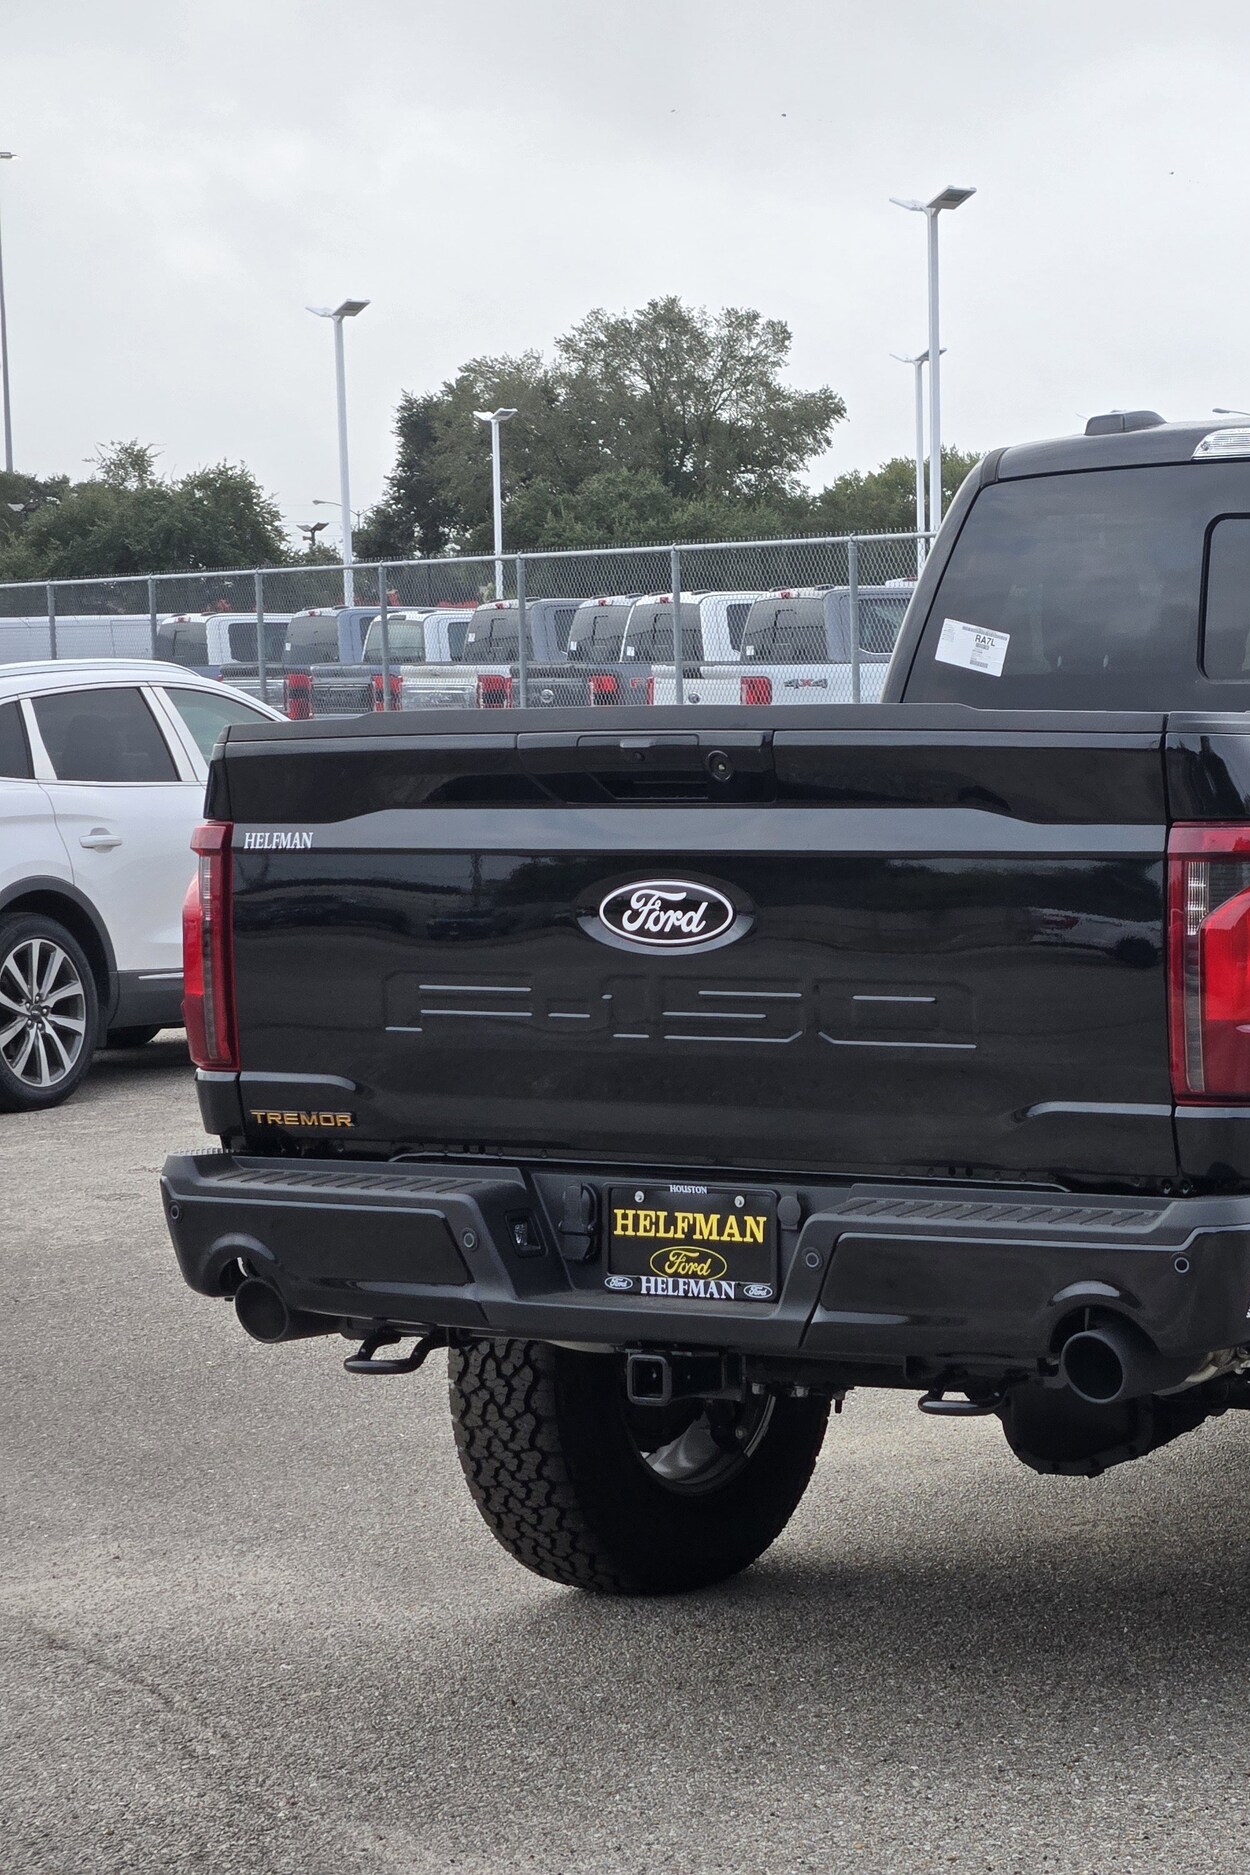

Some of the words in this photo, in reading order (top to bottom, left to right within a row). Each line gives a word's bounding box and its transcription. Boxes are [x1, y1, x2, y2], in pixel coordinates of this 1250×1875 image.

[974, 634, 995, 646] RA7L
[243, 832, 314, 849] HELFMAN
[621, 888, 710, 934] Ford
[249, 1109, 355, 1127] TREMOR
[669, 1184, 707, 1194] HOUSTON
[613, 1208, 767, 1243] HELFMAN
[664, 1249, 712, 1276] Ford
[639, 1275, 736, 1300] HELFMAN
